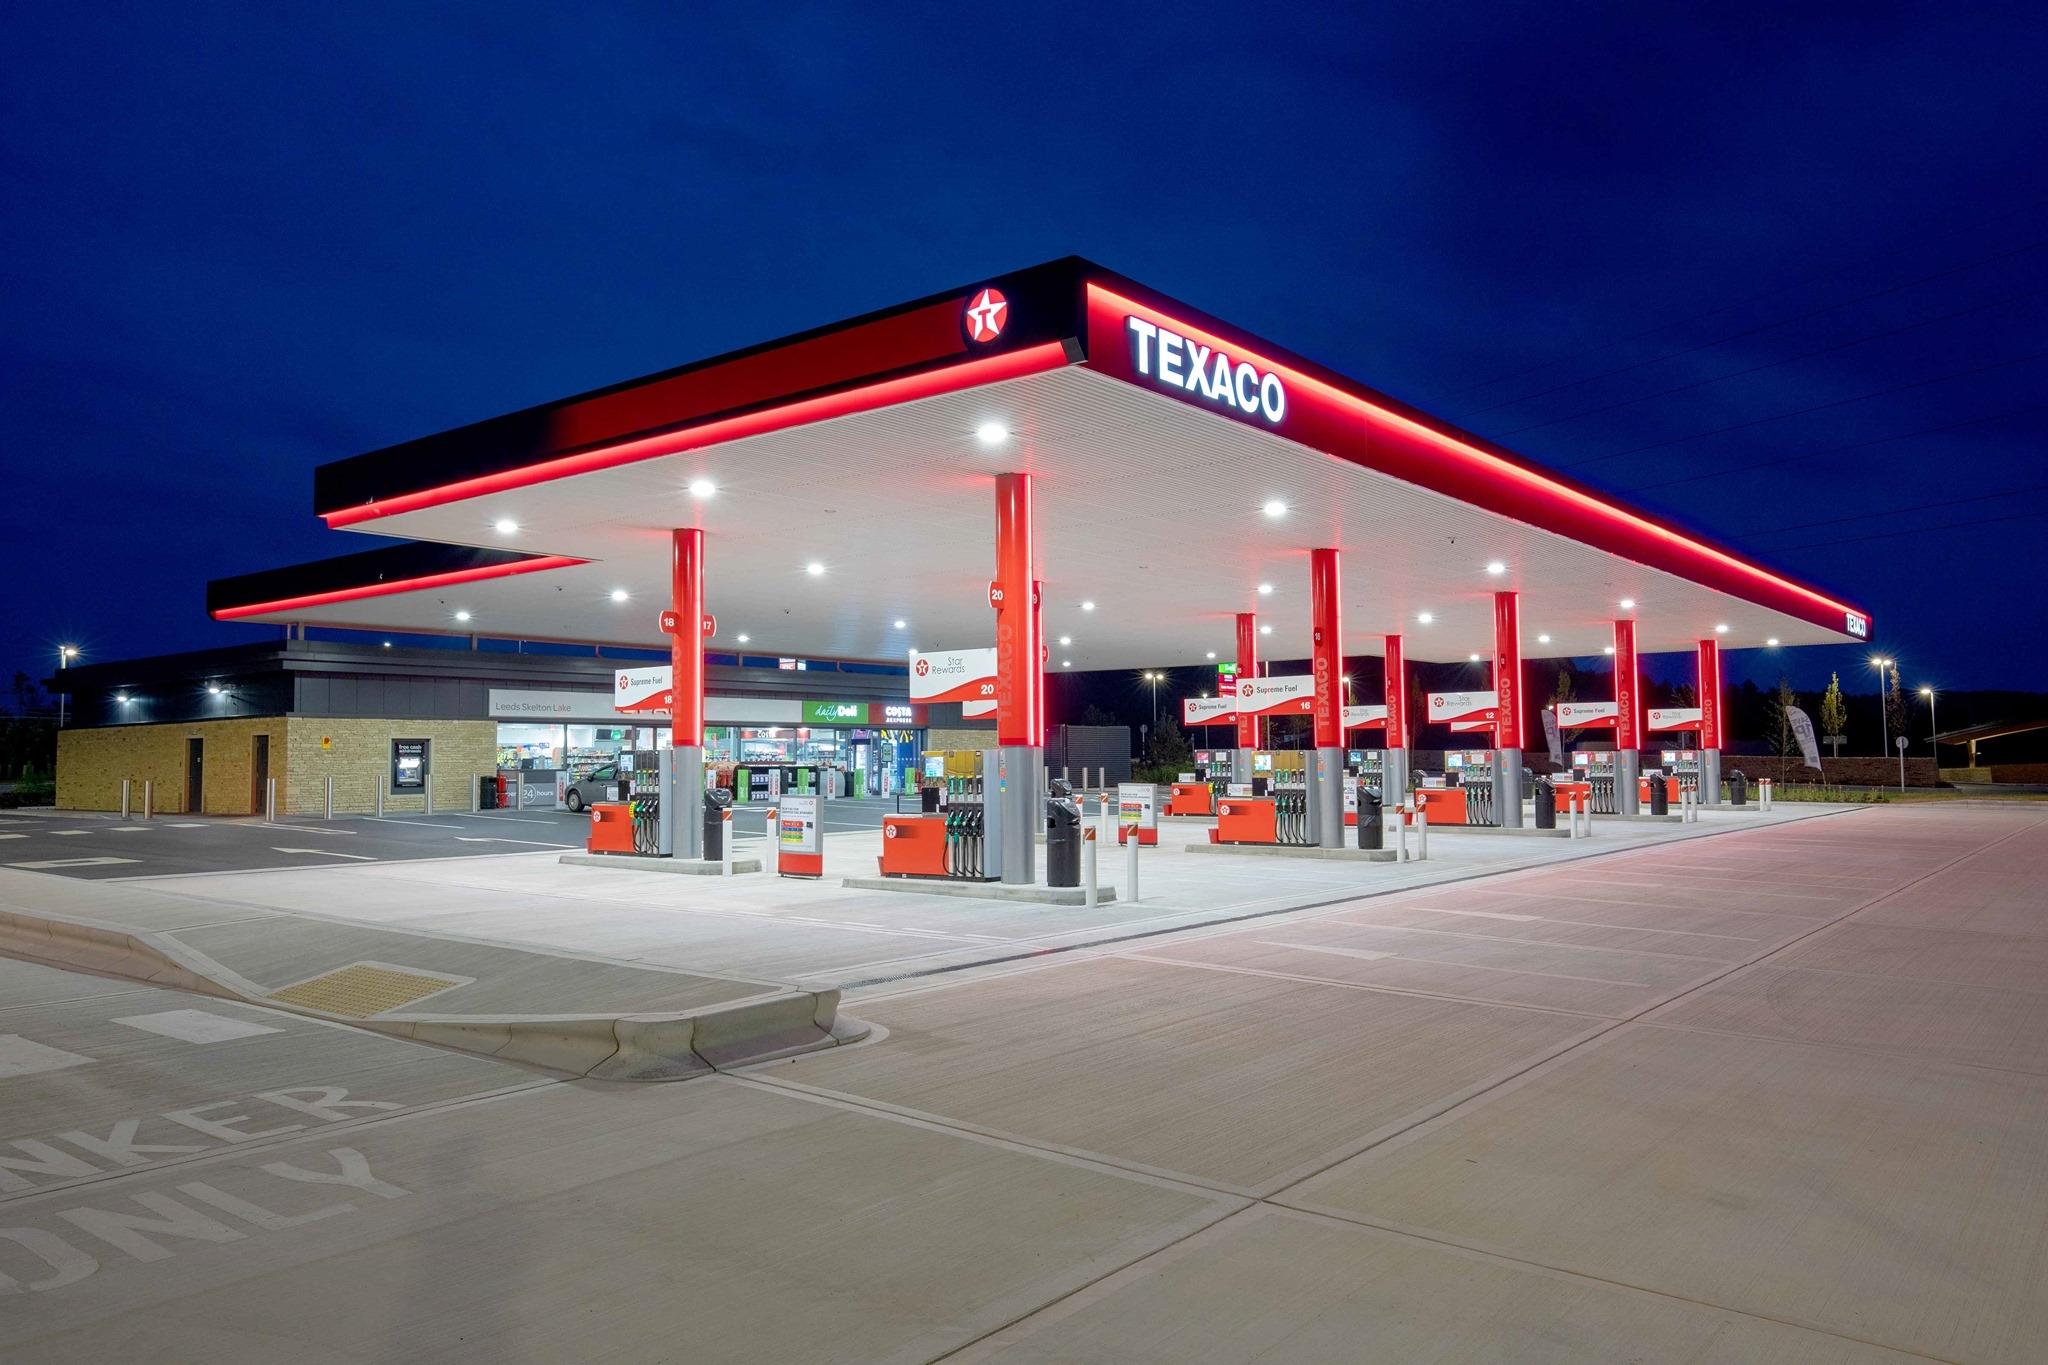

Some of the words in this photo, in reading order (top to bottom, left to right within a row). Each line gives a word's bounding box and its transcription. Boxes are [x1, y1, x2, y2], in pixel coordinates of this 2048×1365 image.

[1128, 315, 1286, 423] TEXACO
[992, 589, 1004, 600] 20
[664, 618, 675, 627] 18
[947, 656, 963, 666] Star
[932, 666, 966, 675] Rewards
[1000, 624, 1013, 721] TEXACO
[630, 678, 652, 686] Supreme
[652, 676, 663, 685] Fuel
[981, 684, 994, 695] 20
[1316, 657, 1330, 729] TEXACO
[495, 702, 520, 711] Leeds
[522, 703, 552, 712] Skelton
[553, 704, 572, 712] Lake
[1300, 701, 1310, 709] 16
[1501, 678, 1512, 735] TEXACO
[885, 706, 912, 717] COSTA
[1388, 695, 1397, 737] TEXACO
[1620, 691, 1630, 737] TEXACO
[1704, 699, 1713, 739] TEXACO
[523, 789, 533, 798] 24
